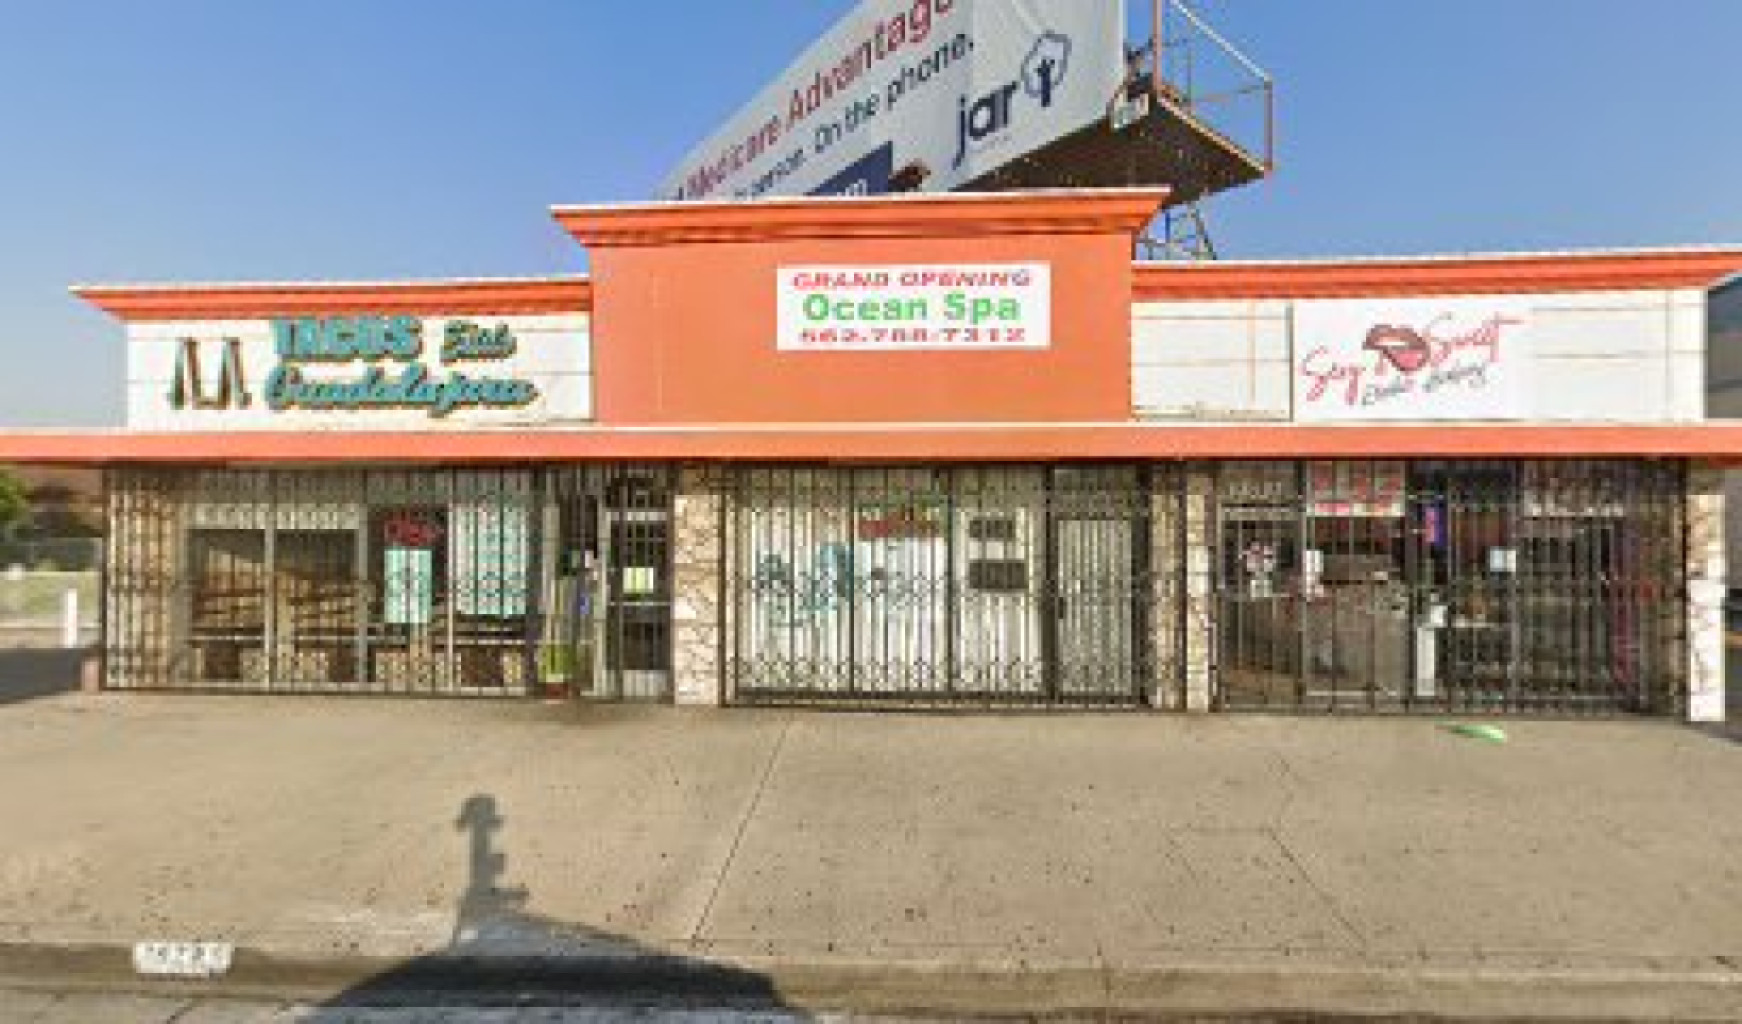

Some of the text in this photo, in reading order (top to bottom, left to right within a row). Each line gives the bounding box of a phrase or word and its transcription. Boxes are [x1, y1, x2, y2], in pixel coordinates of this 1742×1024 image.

[845, 93, 881, 132] the
[886, 32, 975, 110] phone.
[952, 80, 1018, 169] jar
[793, 269, 1031, 289] GRAND OPENING
[803, 291, 1021, 324] Ocean Spa
[270, 314, 422, 361] TACOS
[264, 363, 539, 417] Guadalajara
